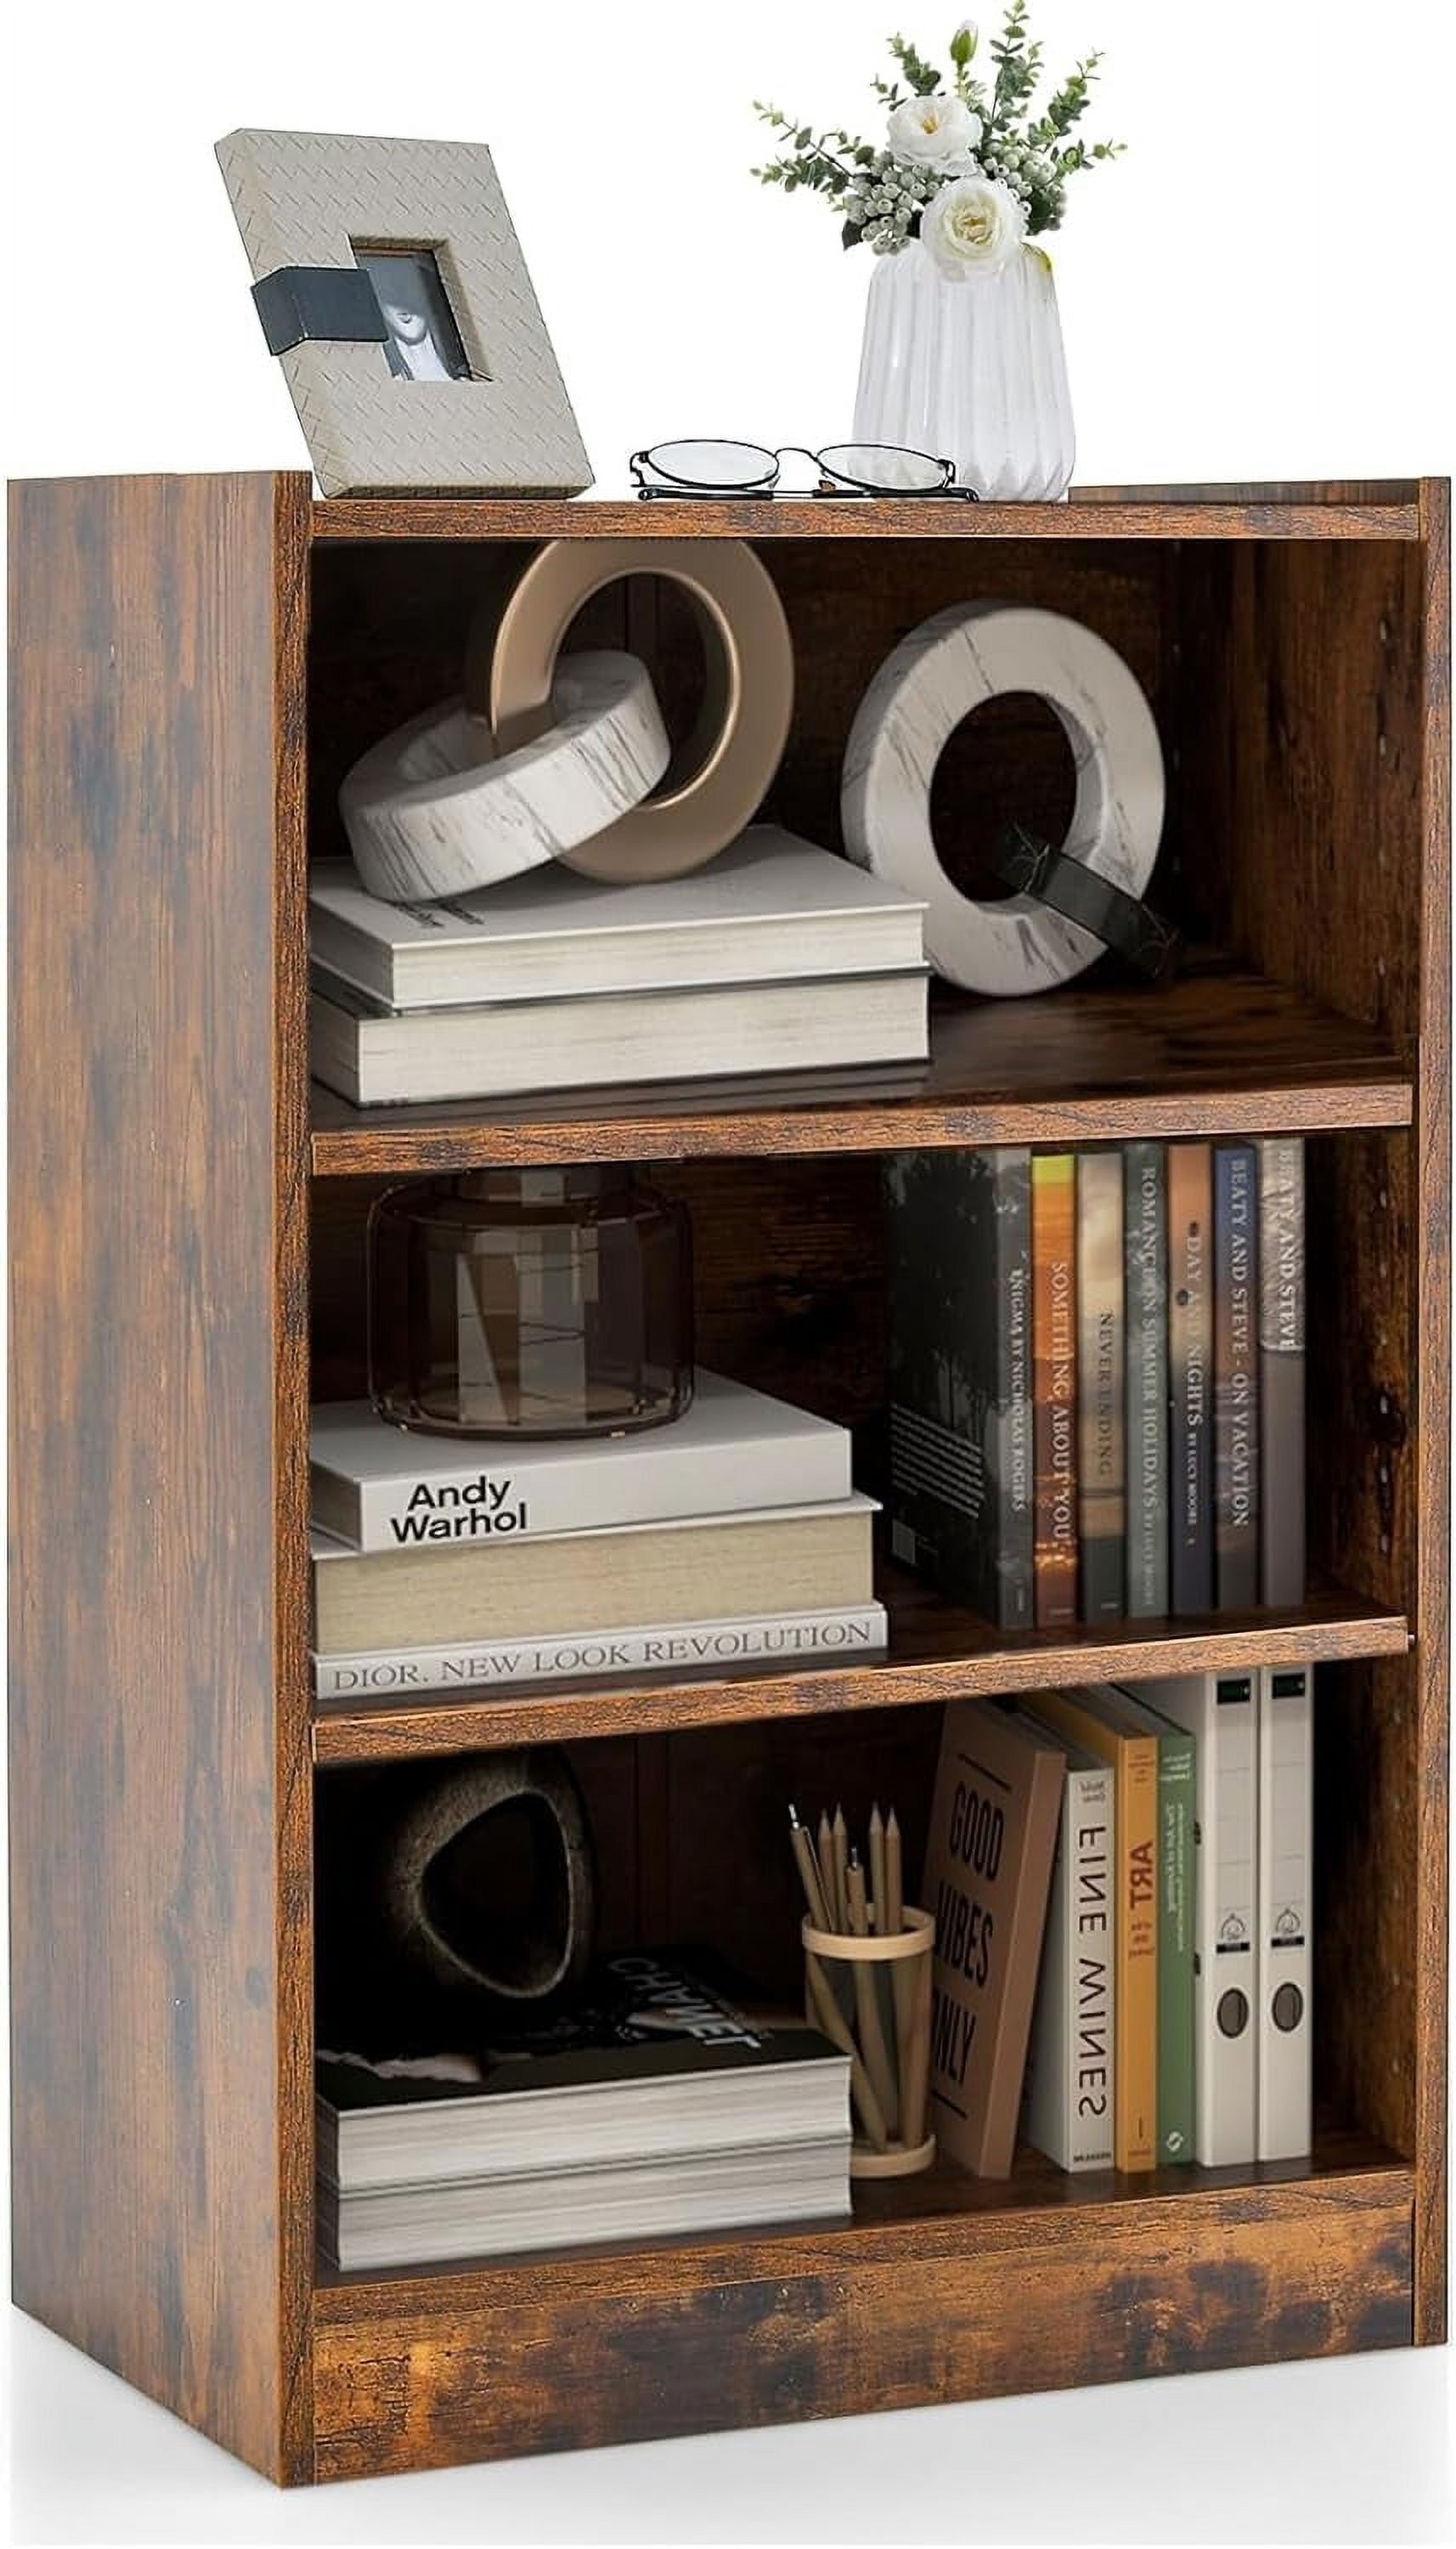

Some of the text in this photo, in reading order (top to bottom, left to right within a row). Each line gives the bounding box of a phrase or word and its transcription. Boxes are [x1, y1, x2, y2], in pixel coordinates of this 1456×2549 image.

[1231, 1157, 1249, 1226] BEATY
[1187, 1237, 1202, 1280] DAY
[1232, 1234, 1249, 1280] AND
[1278, 1229, 1297, 1279] AND
[1232, 1288, 1249, 1355] STEVE
[1141, 1318, 1157, 1401] SUMMER
[1187, 1345, 1203, 1426] NIGHTS
[1232, 1373, 1249, 1404] ON
[1051, 1262, 1071, 1540] SOMETHING ABOUT YOU
[407, 1474, 511, 1511] Andy
[1142, 1407, 1158, 1509] HOLIDAYS
[1232, 1411, 1249, 1527] VACATION
[390, 1501, 527, 1543] Warhol
[334, 1621, 870, 1691] DIOR. NEW LOOK REVOLUTION
[949, 1779, 1005, 1883] GOOD
[935, 1879, 994, 1989] VIBES
